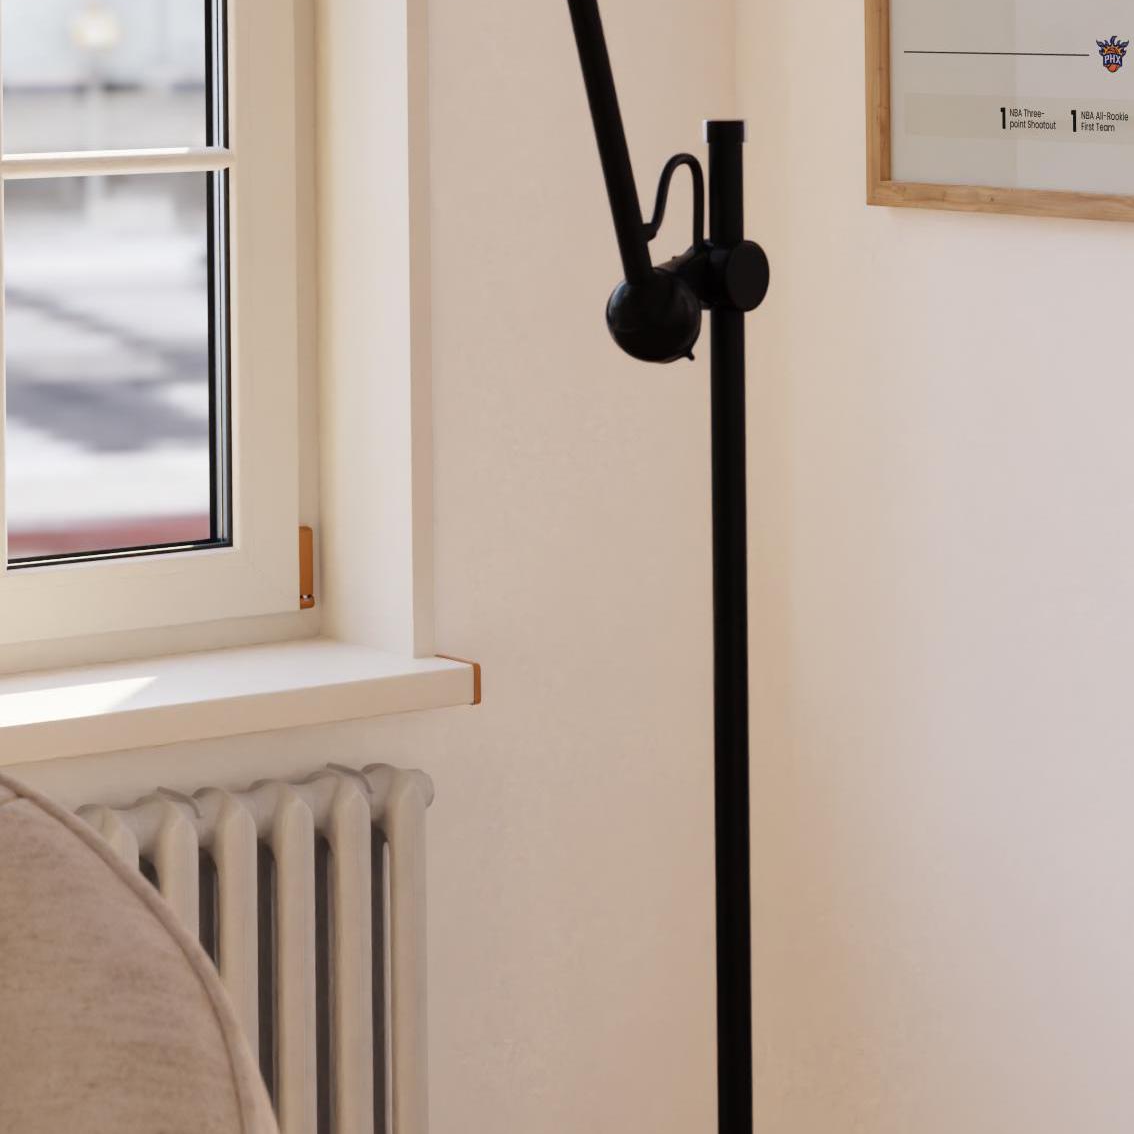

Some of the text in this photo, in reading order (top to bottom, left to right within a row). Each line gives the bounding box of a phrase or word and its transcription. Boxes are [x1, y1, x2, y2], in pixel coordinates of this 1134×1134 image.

[1103, 54, 1122, 65] PHX
[1000, 107, 1006, 129] 1
[1009, 108, 1045, 119] NBA Three-
[1080, 111, 1129, 121] NBA All-Rookie
[1009, 120, 1057, 130] point Shootout
[1071, 110, 1077, 132] 1
[1080, 122, 1115, 132] First Team
